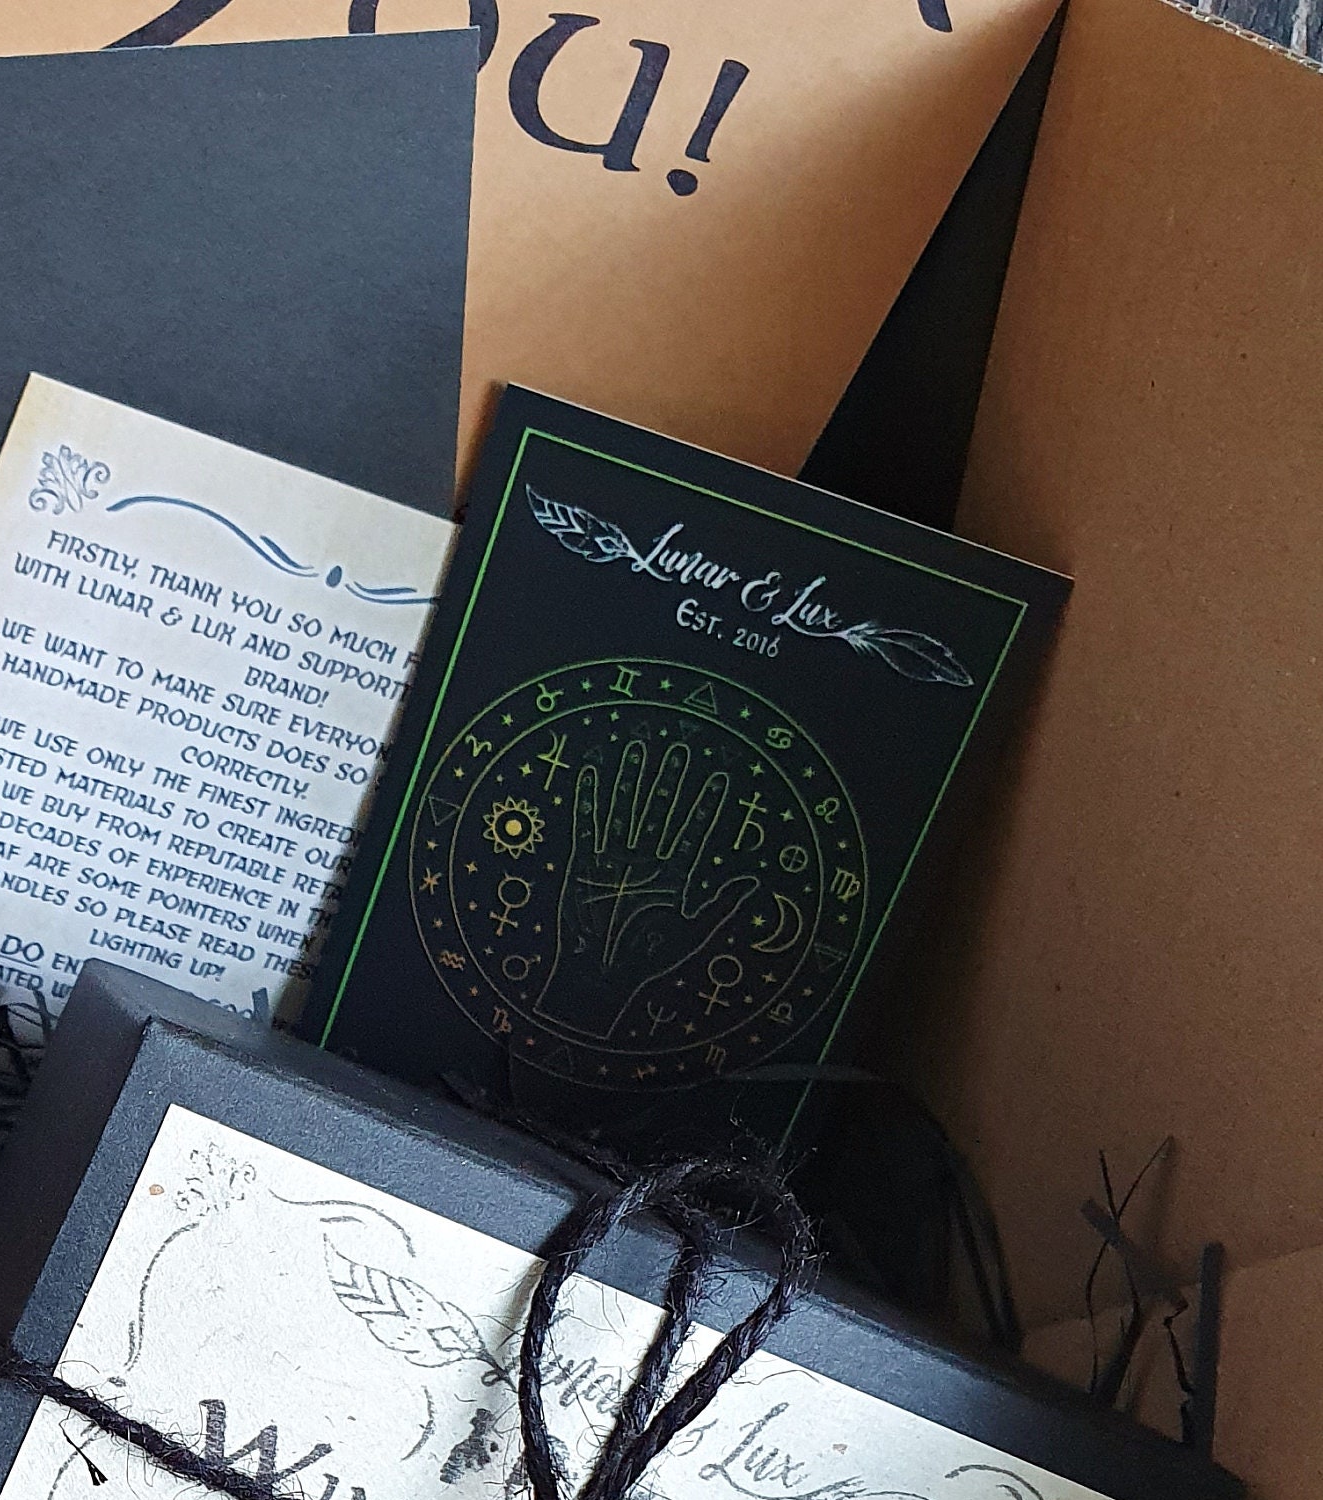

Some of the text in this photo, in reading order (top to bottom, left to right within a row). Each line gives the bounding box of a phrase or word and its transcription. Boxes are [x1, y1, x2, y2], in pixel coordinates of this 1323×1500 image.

[14, 552, 70, 589] WITH
[78, 575, 153, 618] LUNAR
[160, 606, 183, 627] &
[191, 614, 237, 646] LUX
[240, 632, 290, 661] AND
[47, 530, 140, 580] FIRSTLY,
[150, 565, 222, 607] THANK
[232, 591, 283, 625] YOU
[287, 613, 323, 638] SO
[329, 626, 397, 665] MUCH
[631, 524, 844, 637] Lunar & Lux
[2, 617, 36, 645] WE
[44, 632, 109, 669] WANT
[116, 656, 144, 680] TO
[151, 668, 216, 705] MAKE
[221, 693, 281, 726] SURE
[732, 627, 781, 658] 2016
[2, 652, 369, 785] HANDMADE PRODUCTS DOES SO
[244, 666, 330, 708] BRAND!
[34, 728, 79, 757] USE
[86, 747, 146, 778] ONLY
[152, 767, 192, 793] THE
[197, 781, 272, 819] FINEST
[275, 805, 360, 847] INGRED
[55, 767, 176, 820] MATERIALS
[182, 808, 210, 830] TO
[217, 820, 298, 858] CREATE
[180, 745, 311, 800] CORRECTLY.
[1, 780, 34, 806] WE
[41, 794, 90, 823] BUY
[94, 811, 162, 846] FROM
[167, 833, 287, 885] REPUTABLE
[24, 852, 71, 878] ARE
[77, 867, 142, 900] SOME
[146, 888, 252, 933] POINTERS
[108, 847, 141, 868] OF
[146, 857, 273, 910] EXPERIENCE
[277, 898, 301, 919] IN
[0, 933, 45, 963] DO
[74, 896, 108, 917] SO
[114, 907, 193, 945] PLEASE
[197, 931, 256, 962] READ
[89, 928, 227, 982] LIGHTING UP!
